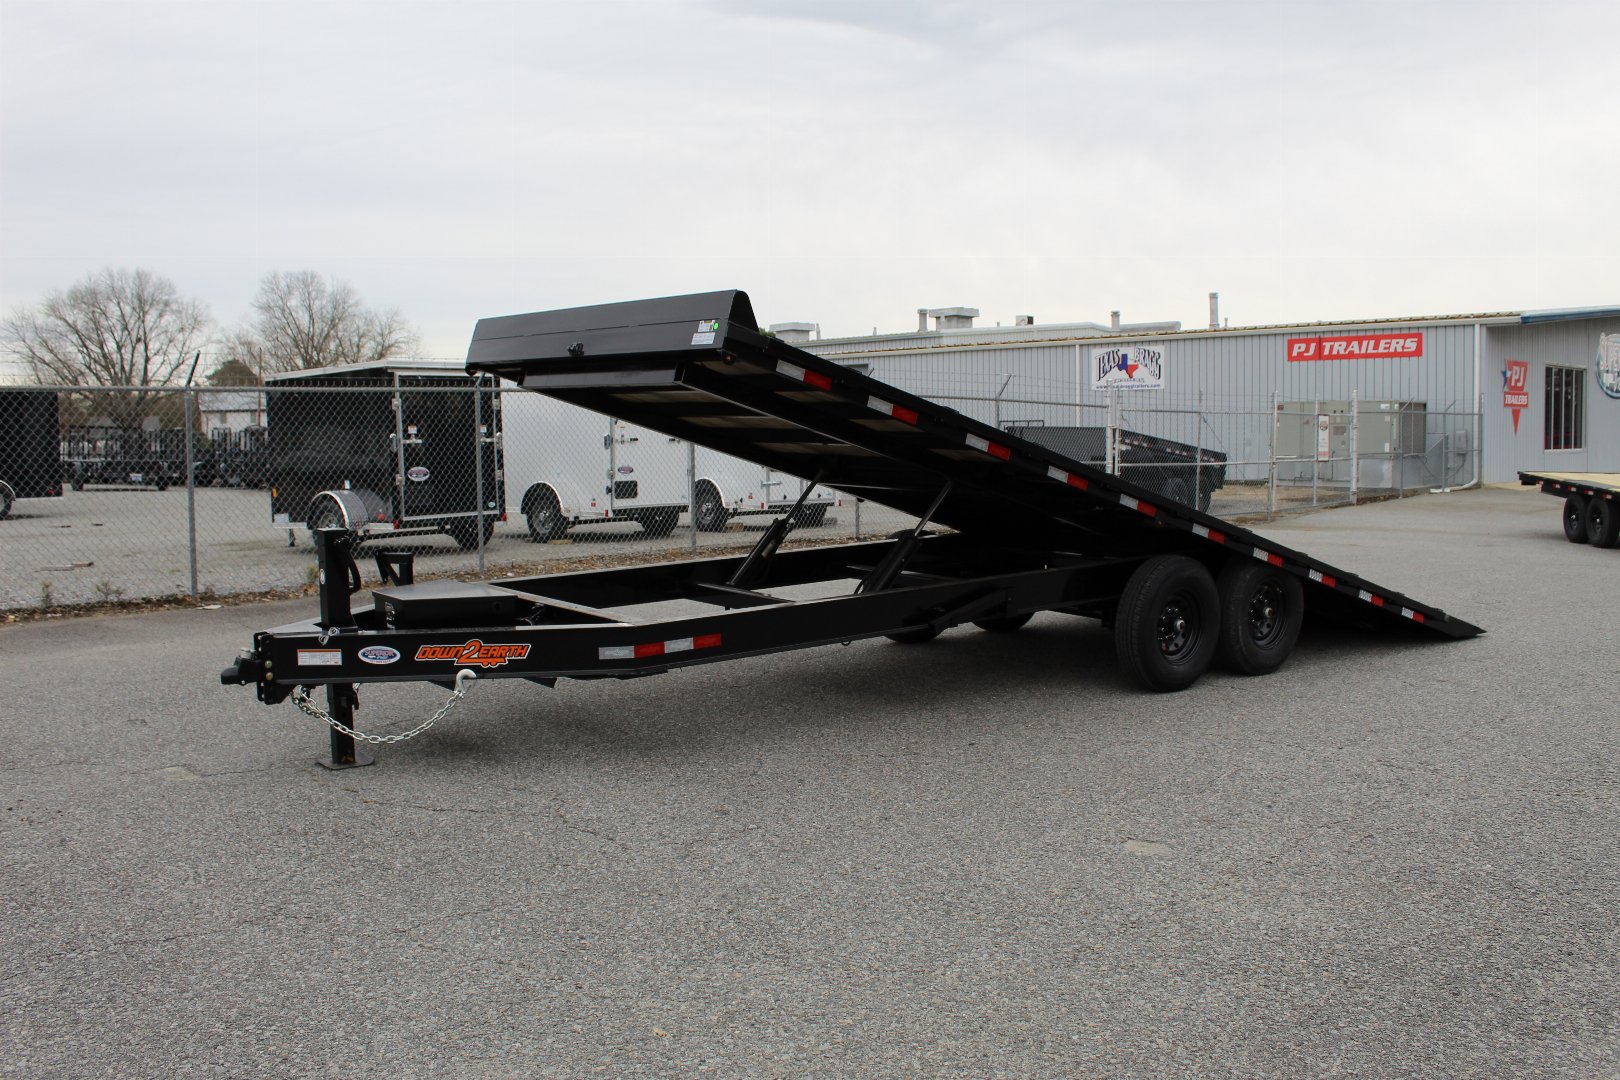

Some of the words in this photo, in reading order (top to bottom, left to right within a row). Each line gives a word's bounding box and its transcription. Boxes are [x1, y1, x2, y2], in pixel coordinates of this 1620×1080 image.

[1292, 342, 1316, 357] PJ
[1322, 338, 1418, 356] TRAILERS
[1095, 348, 1120, 382] TEXAS
[1134, 347, 1161, 380] BRAGG
[1511, 365, 1525, 387] PJ
[1505, 394, 1528, 405] TRAILERS
